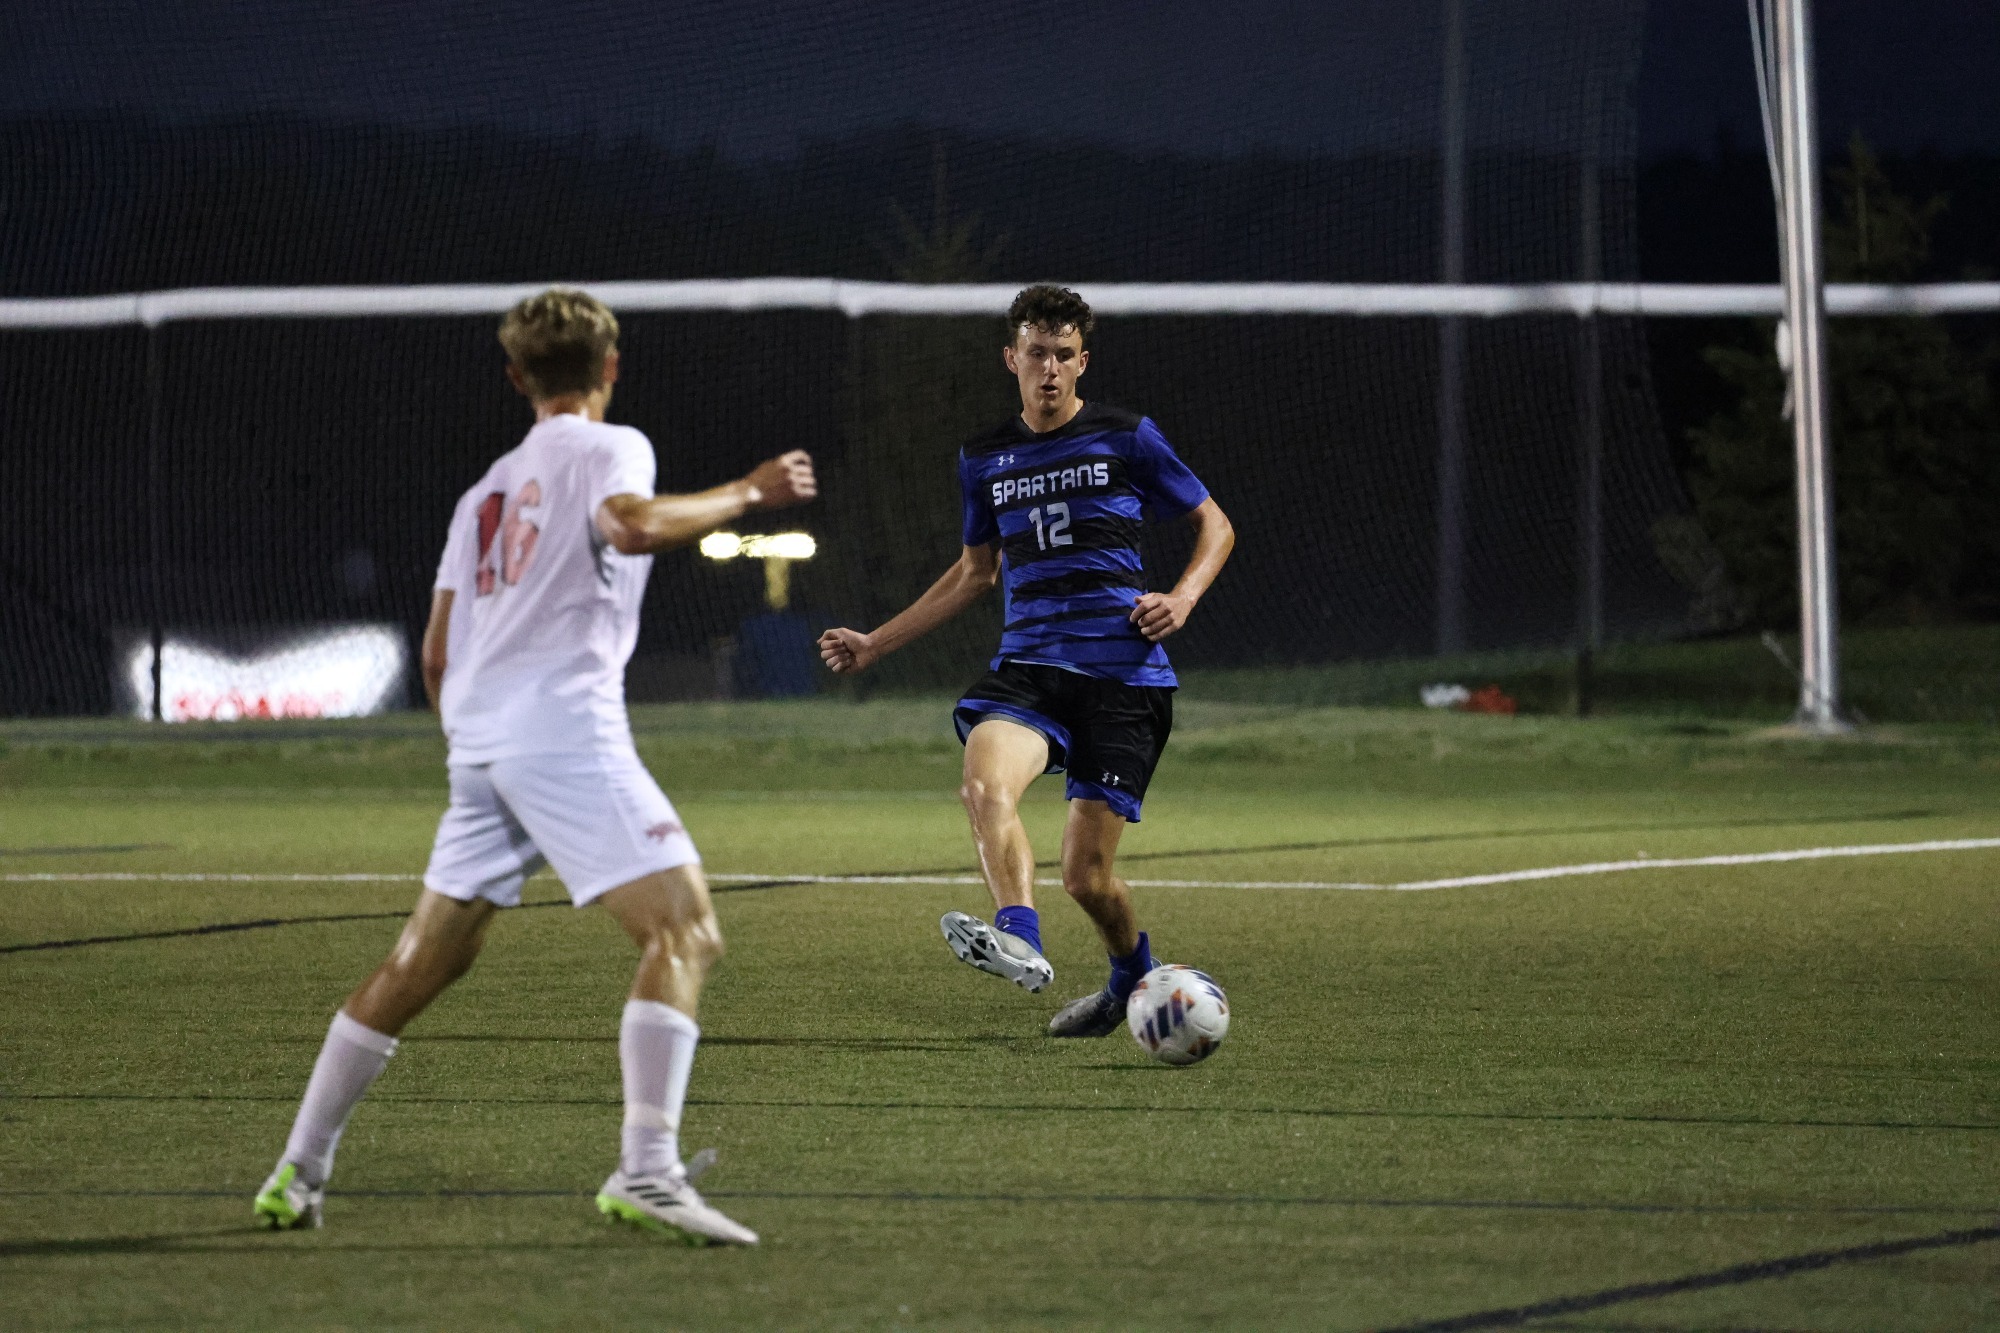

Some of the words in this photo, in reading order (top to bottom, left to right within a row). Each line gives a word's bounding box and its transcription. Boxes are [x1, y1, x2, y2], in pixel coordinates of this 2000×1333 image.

[992, 462, 1109, 506] SPARTANS
[476, 478, 541, 598] 16
[1028, 502, 1073, 551] 12
